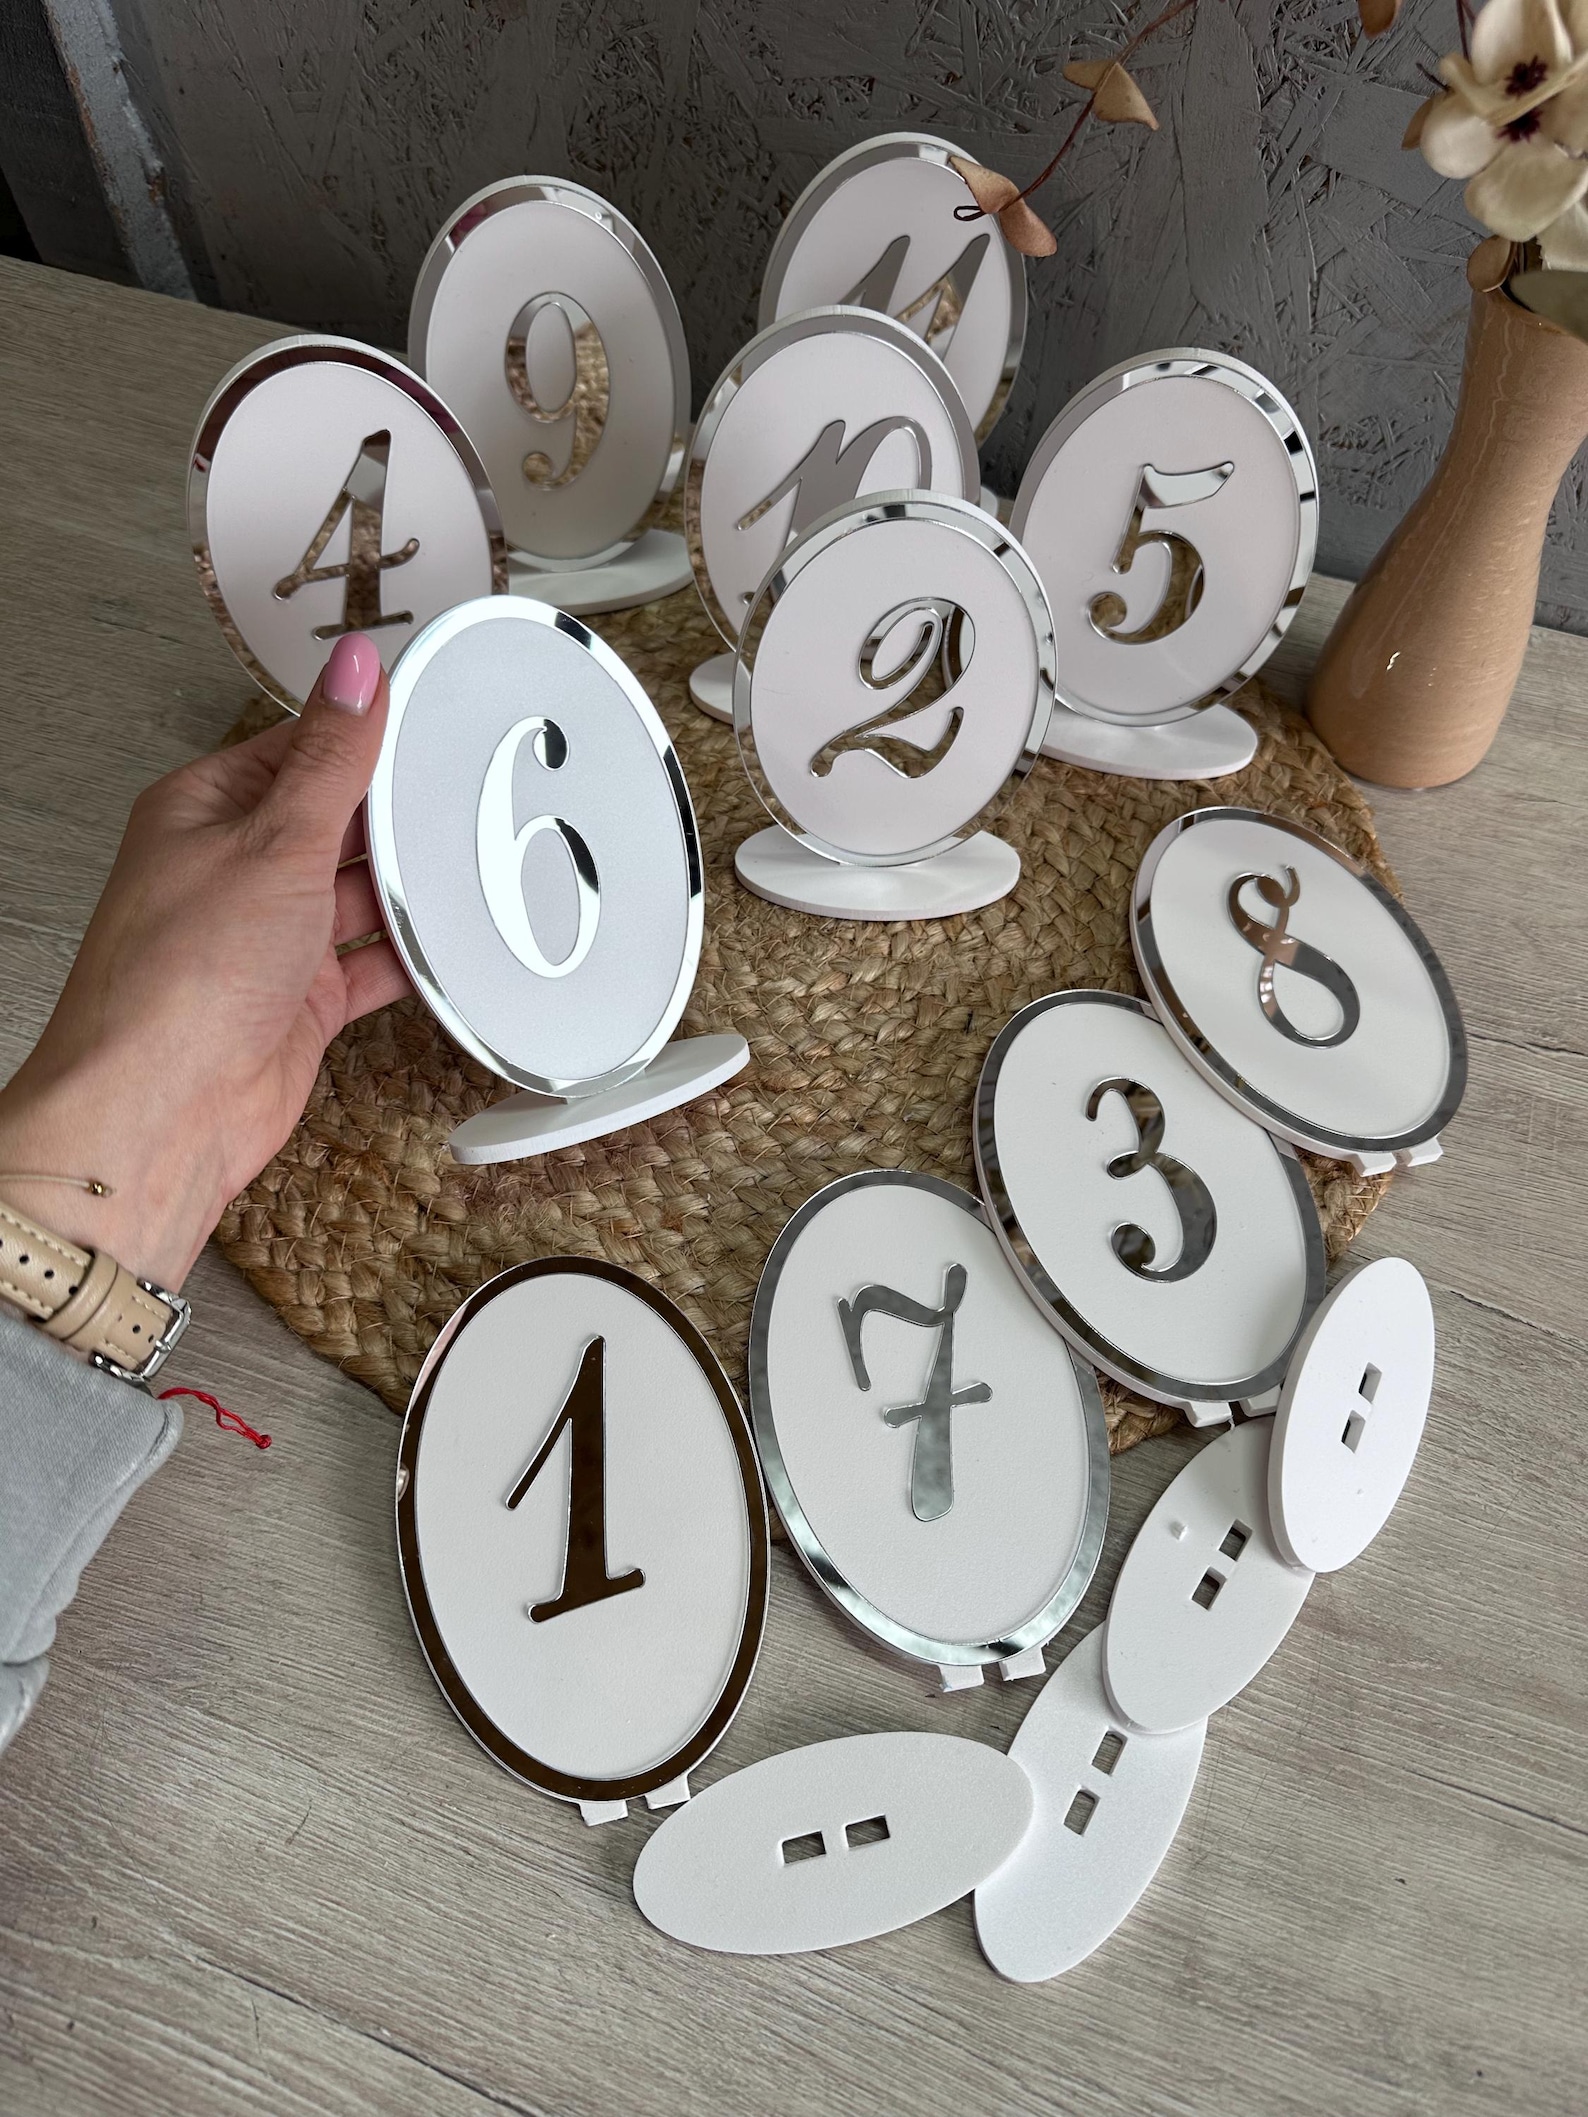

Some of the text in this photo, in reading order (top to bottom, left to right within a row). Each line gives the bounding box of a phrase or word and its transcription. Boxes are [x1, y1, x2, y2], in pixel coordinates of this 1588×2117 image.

[504, 291, 611, 490] 9
[273, 429, 421, 640] 4
[1087, 461, 1236, 646] 5
[809, 597, 976, 779] 2
[476, 716, 600, 978] 6
[1227, 864, 1361, 1049] 8
[1085, 1076, 1217, 1283] 3
[505, 1334, 645, 1624] 1
[837, 1262, 993, 1522] 7
